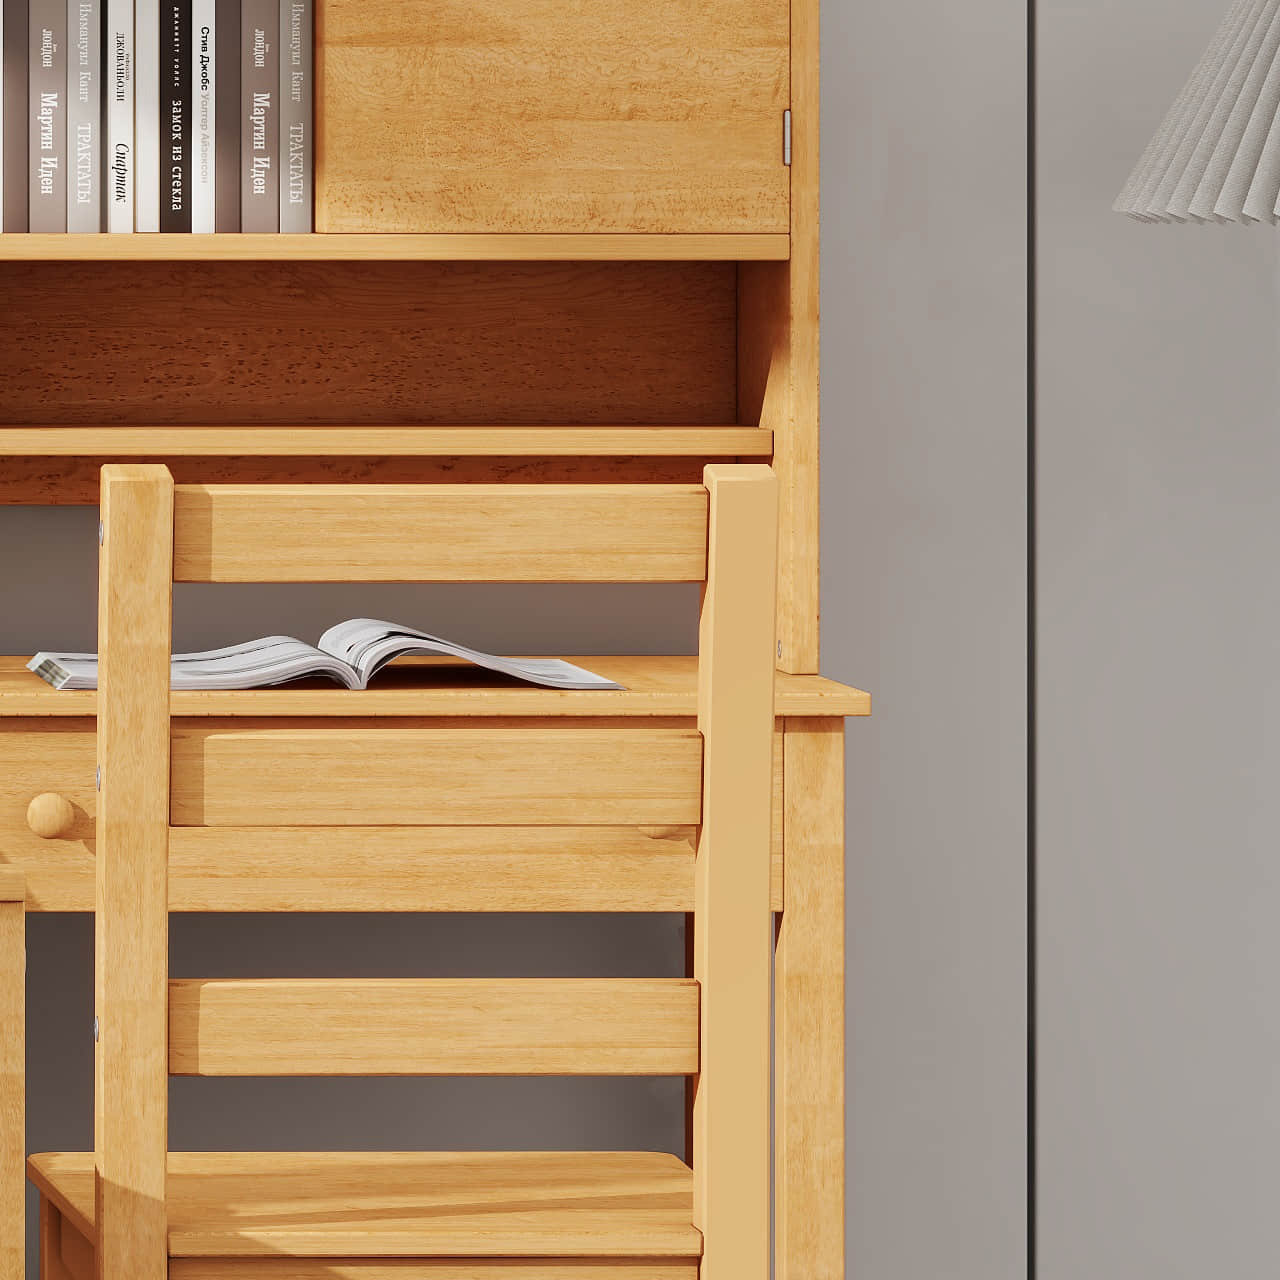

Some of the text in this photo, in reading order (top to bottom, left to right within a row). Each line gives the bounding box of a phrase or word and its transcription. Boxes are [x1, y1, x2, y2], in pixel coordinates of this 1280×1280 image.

[201, 27, 210, 52] Стив
[199, 55, 210, 91] Джобс
[38, 93, 58, 149] Мартин
[172, 100, 183, 140] замок
[250, 93, 270, 149] Мартин
[77, 123, 91, 203] ТРАКТАТЫ
[112, 143, 130, 203] Спартак
[172, 146, 183, 161] из
[290, 123, 304, 203] ТРАКТАТЫ
[38, 156, 58, 194] Иден
[172, 166, 183, 210] стекла
[251, 156, 270, 194] Иден
